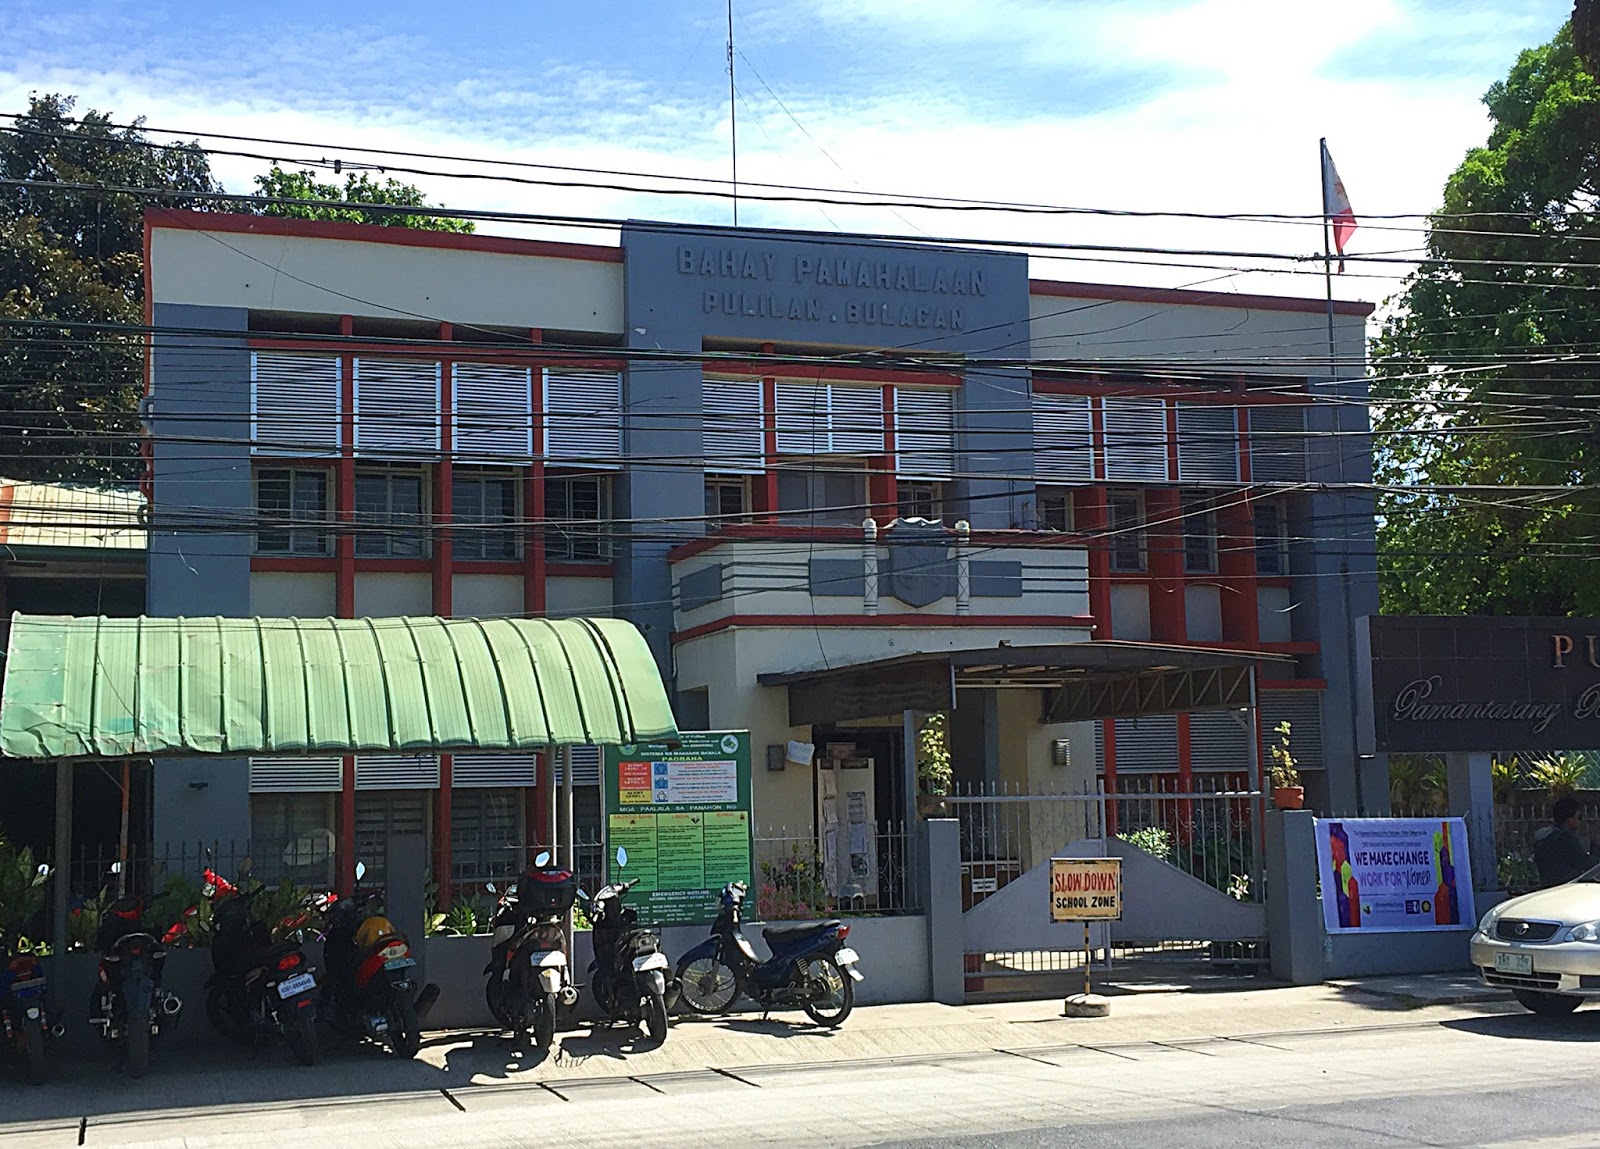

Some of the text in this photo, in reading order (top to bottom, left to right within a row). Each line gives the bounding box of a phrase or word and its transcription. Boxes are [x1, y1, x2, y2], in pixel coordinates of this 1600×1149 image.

[677, 246, 987, 296] BAHAY PAMAHALAAN
[846, 301, 964, 330] BULACAN
[1393, 674, 1561, 734] Pamantasang
[1354, 850, 1430, 866] WE MAKE CHANGE
[1055, 872, 1116, 892] SLOW DOWN
[1358, 872, 1383, 888] WORK
[1384, 871, 1402, 887] FOR
[1056, 896, 1115, 908] SCHOOL ZONE
